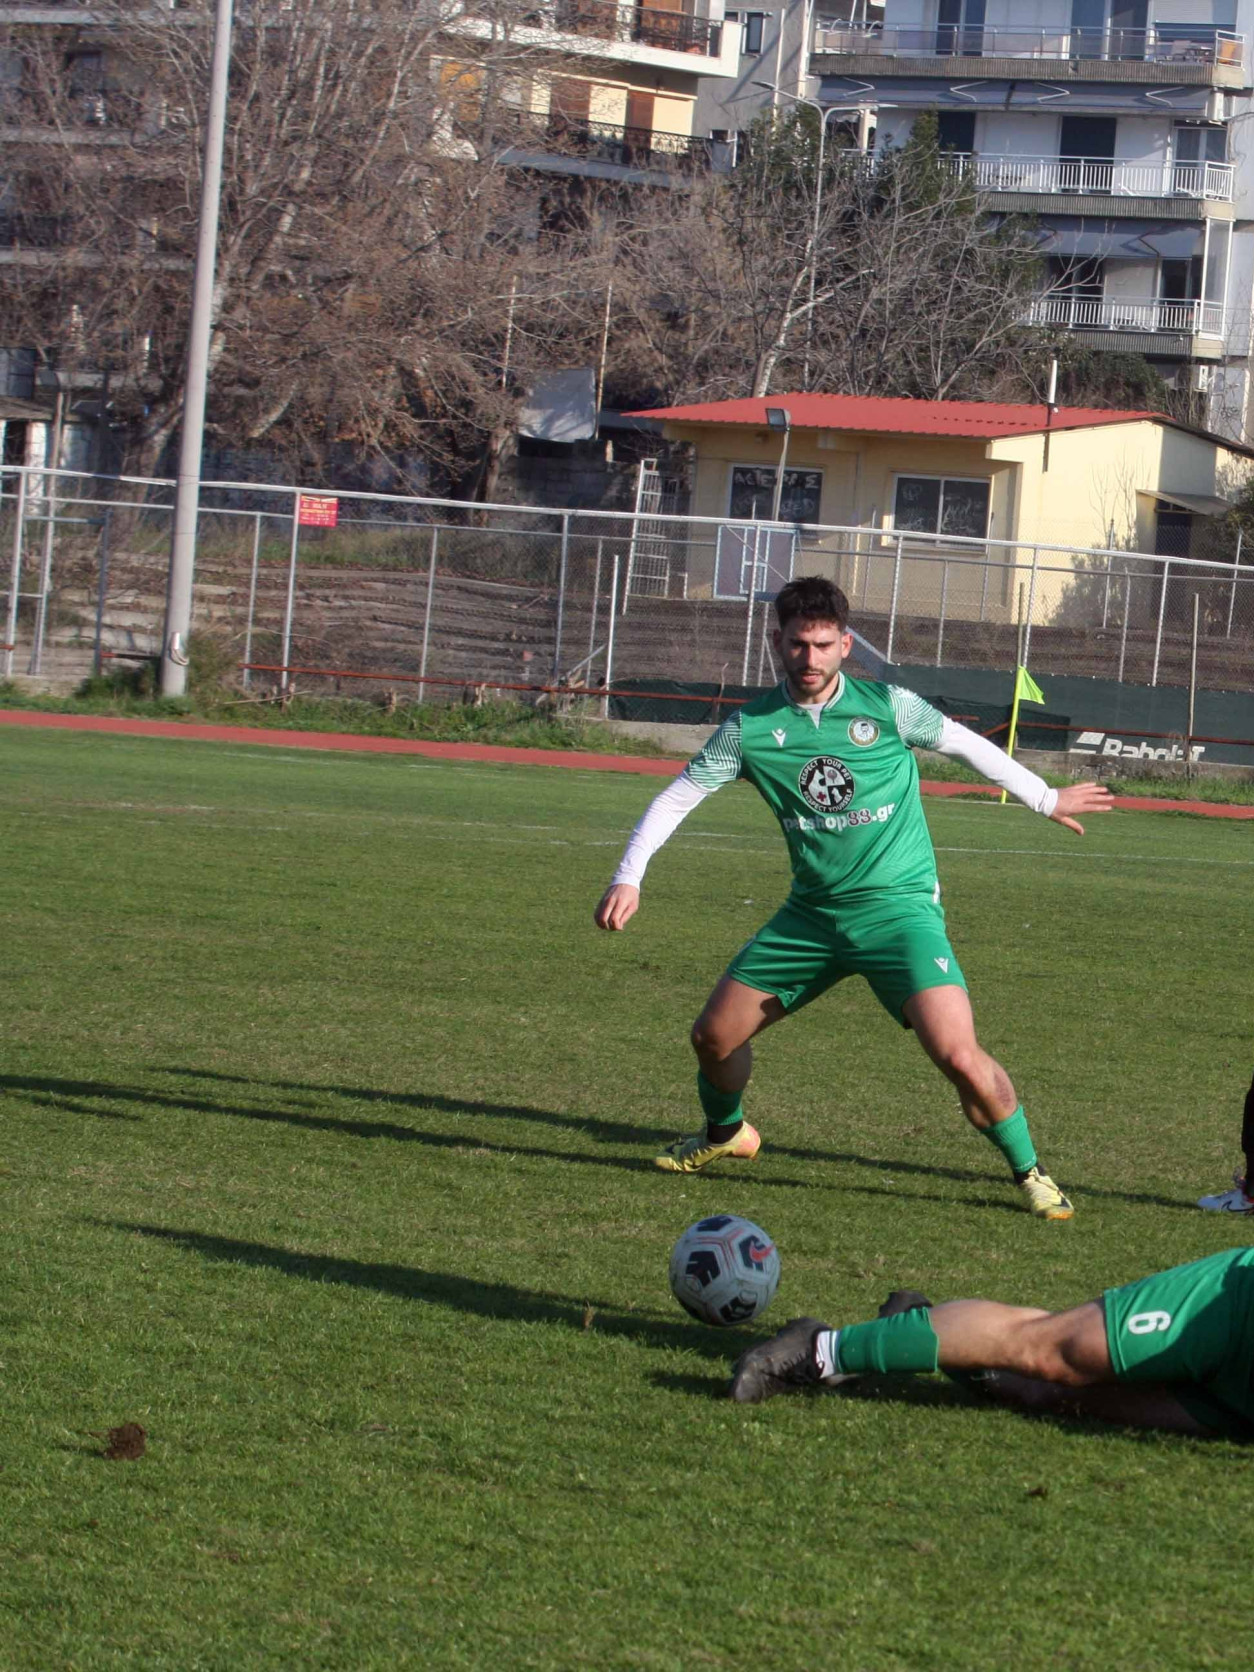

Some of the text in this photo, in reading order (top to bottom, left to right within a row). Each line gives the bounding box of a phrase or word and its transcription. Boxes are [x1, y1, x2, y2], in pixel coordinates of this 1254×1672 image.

[822, 758, 842, 770] YOUR
[841, 768, 852, 781] PET
[1128, 1310, 1171, 1335] 6
